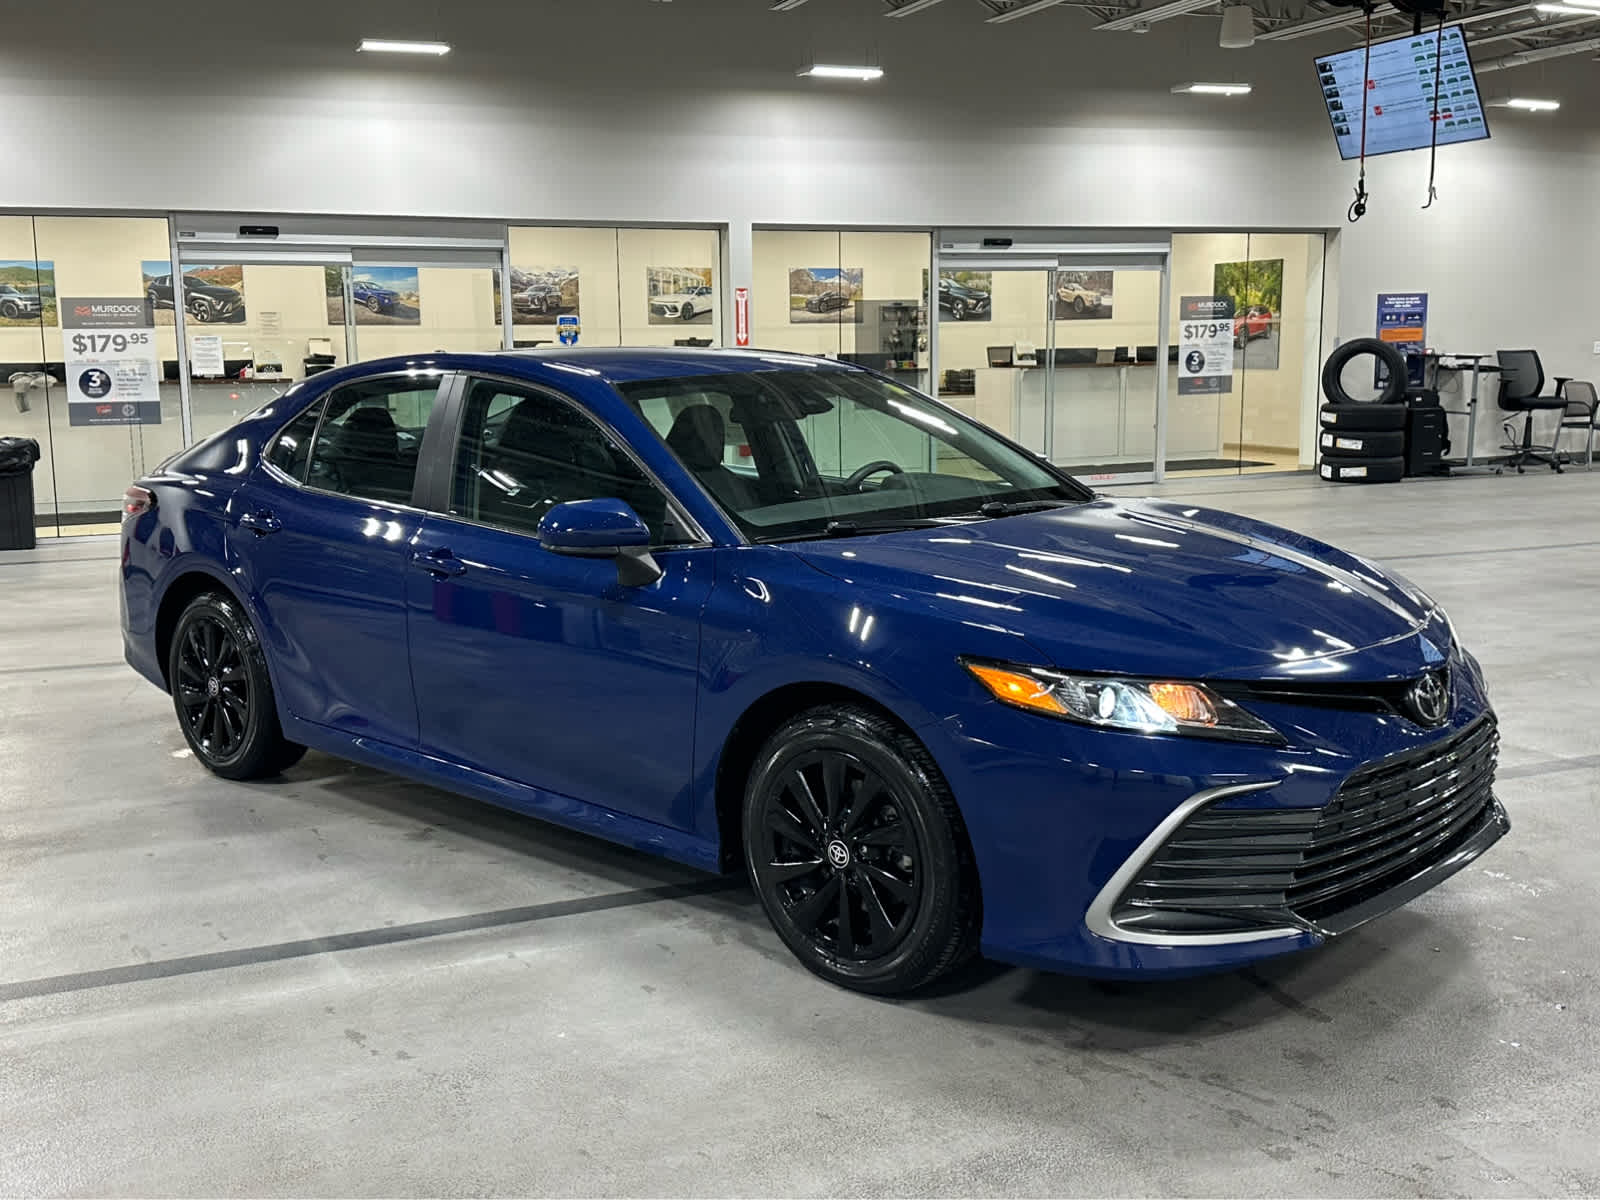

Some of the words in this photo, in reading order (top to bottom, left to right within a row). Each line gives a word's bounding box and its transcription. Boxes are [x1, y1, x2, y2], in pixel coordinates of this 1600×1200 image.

[91, 305, 141, 313] MURDOCK
[1191, 352, 1200, 365] 3
[88, 371, 101, 387] 3
